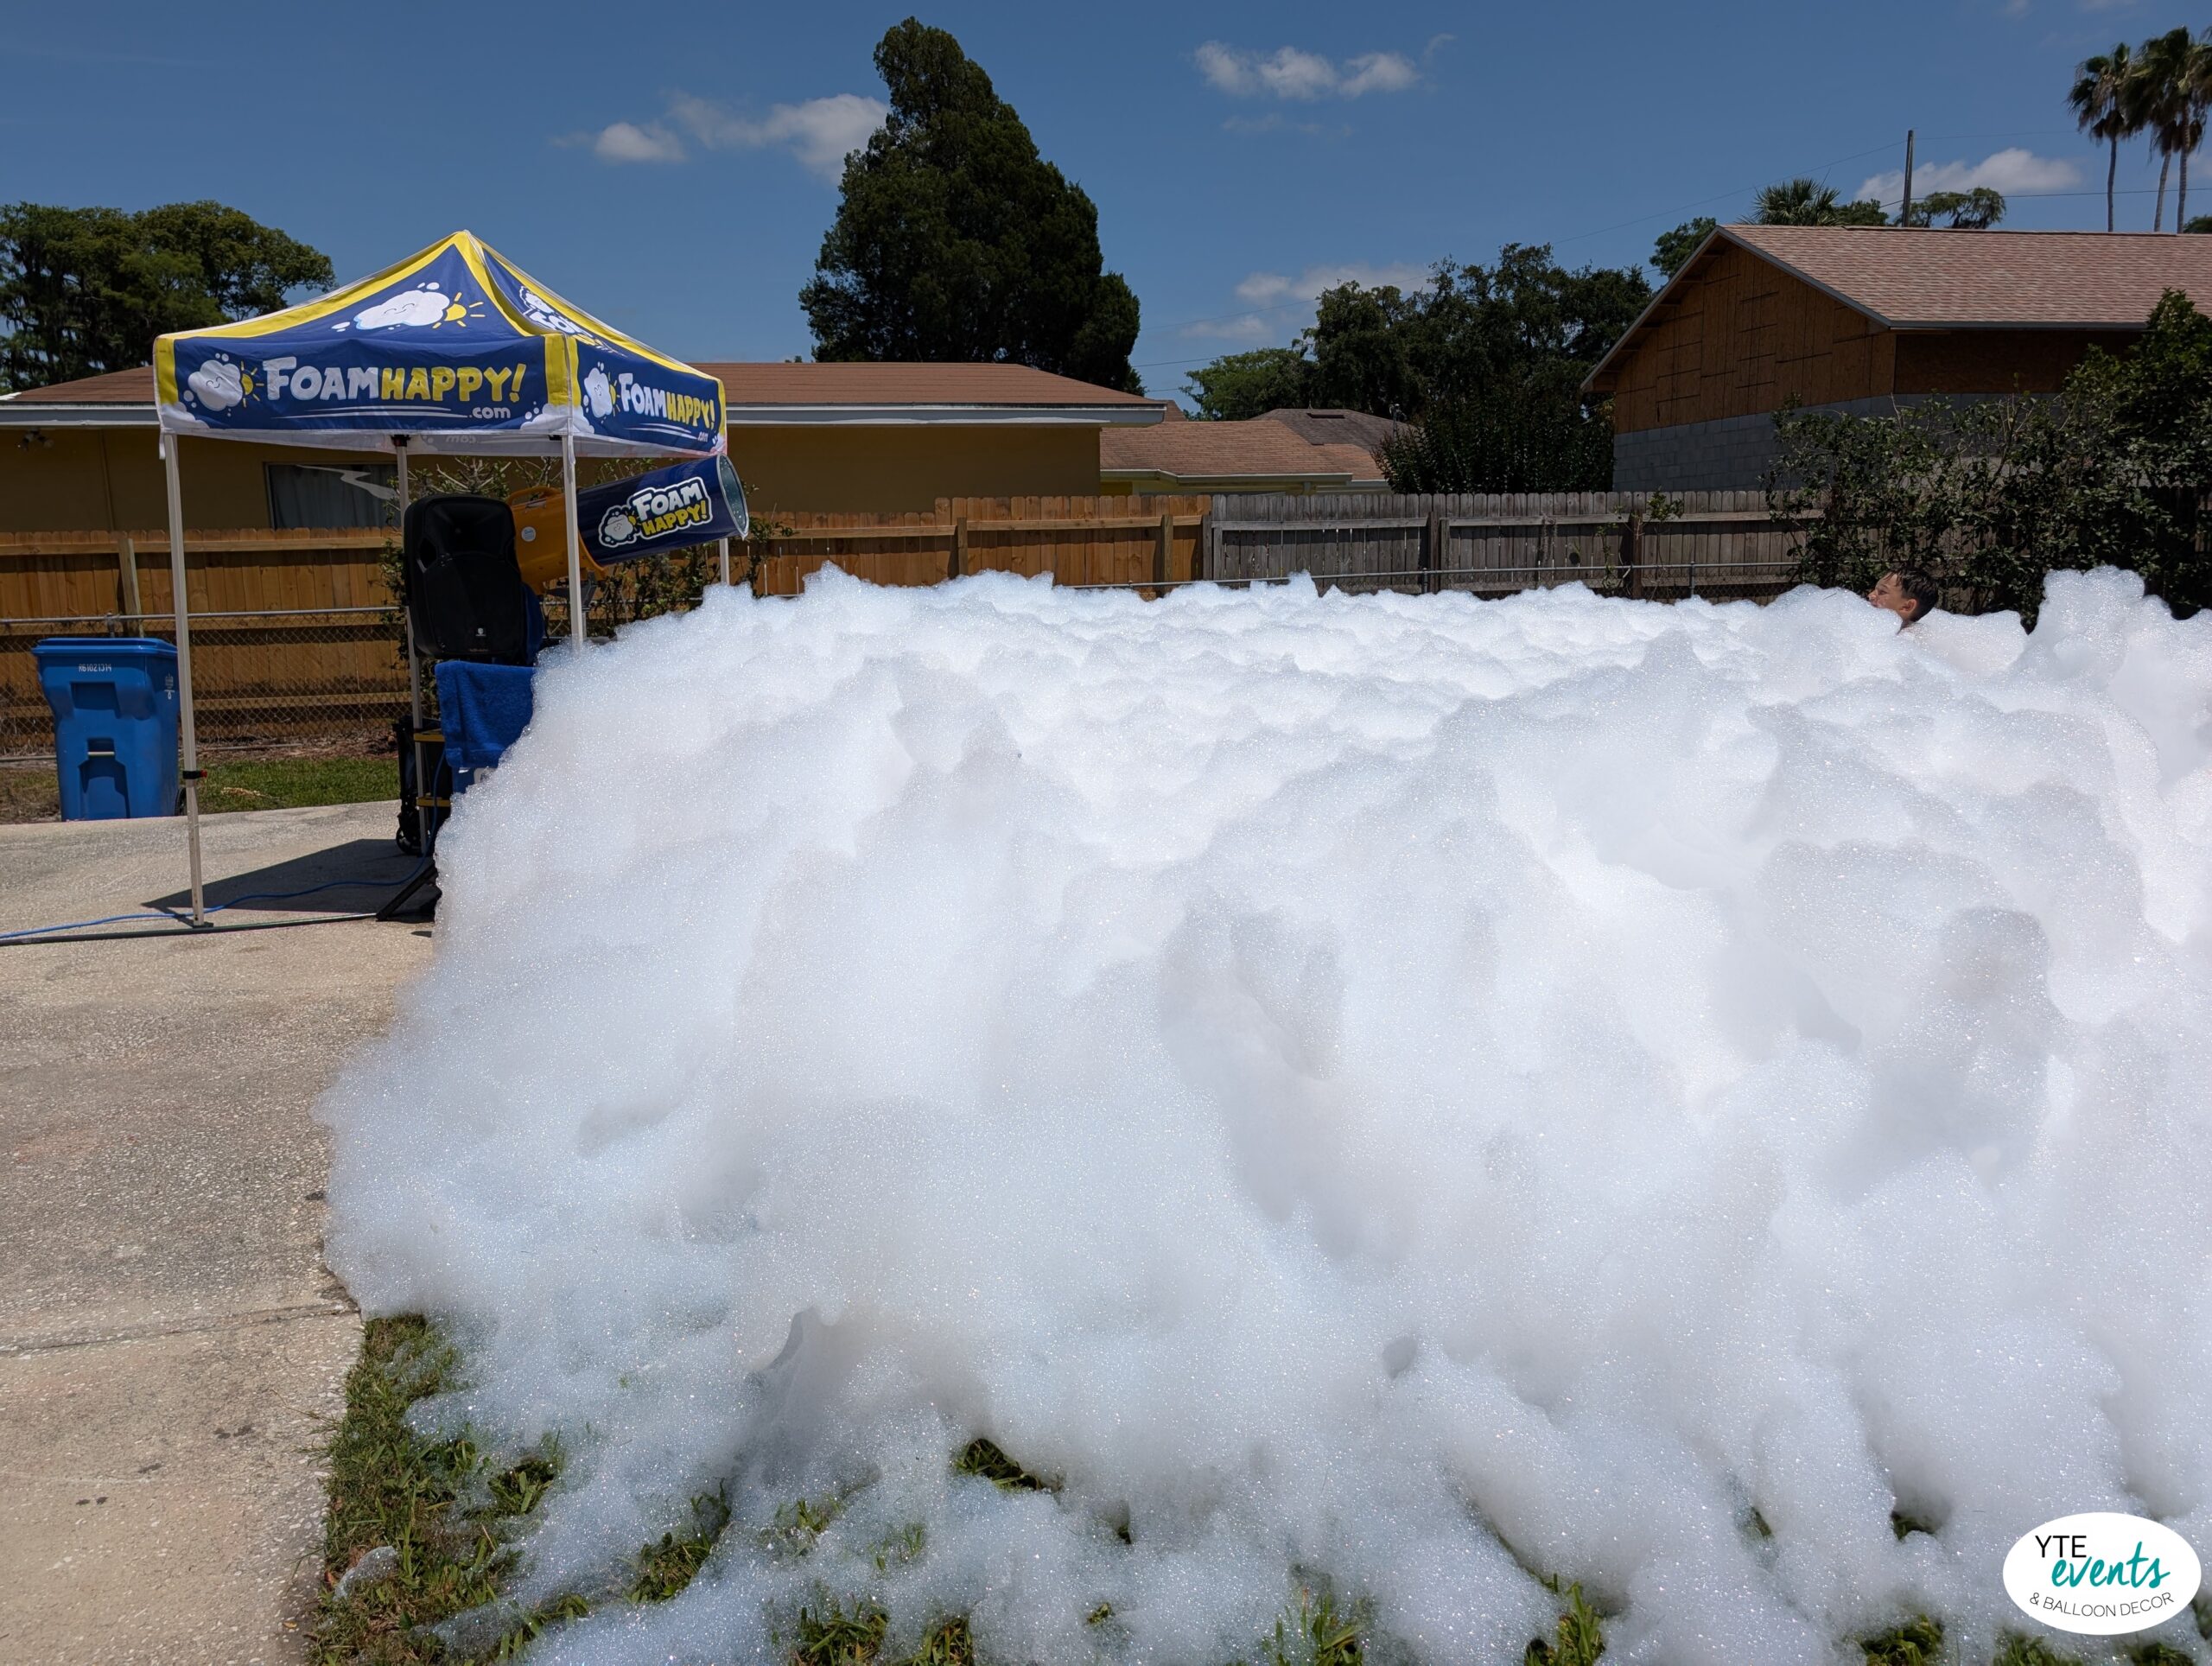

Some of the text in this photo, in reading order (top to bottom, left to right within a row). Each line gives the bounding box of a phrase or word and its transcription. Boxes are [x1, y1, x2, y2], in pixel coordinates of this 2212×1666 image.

[468, 405, 511, 419] .com
[632, 482, 702, 518] FOAM
[641, 500, 708, 536] HAPPY!
